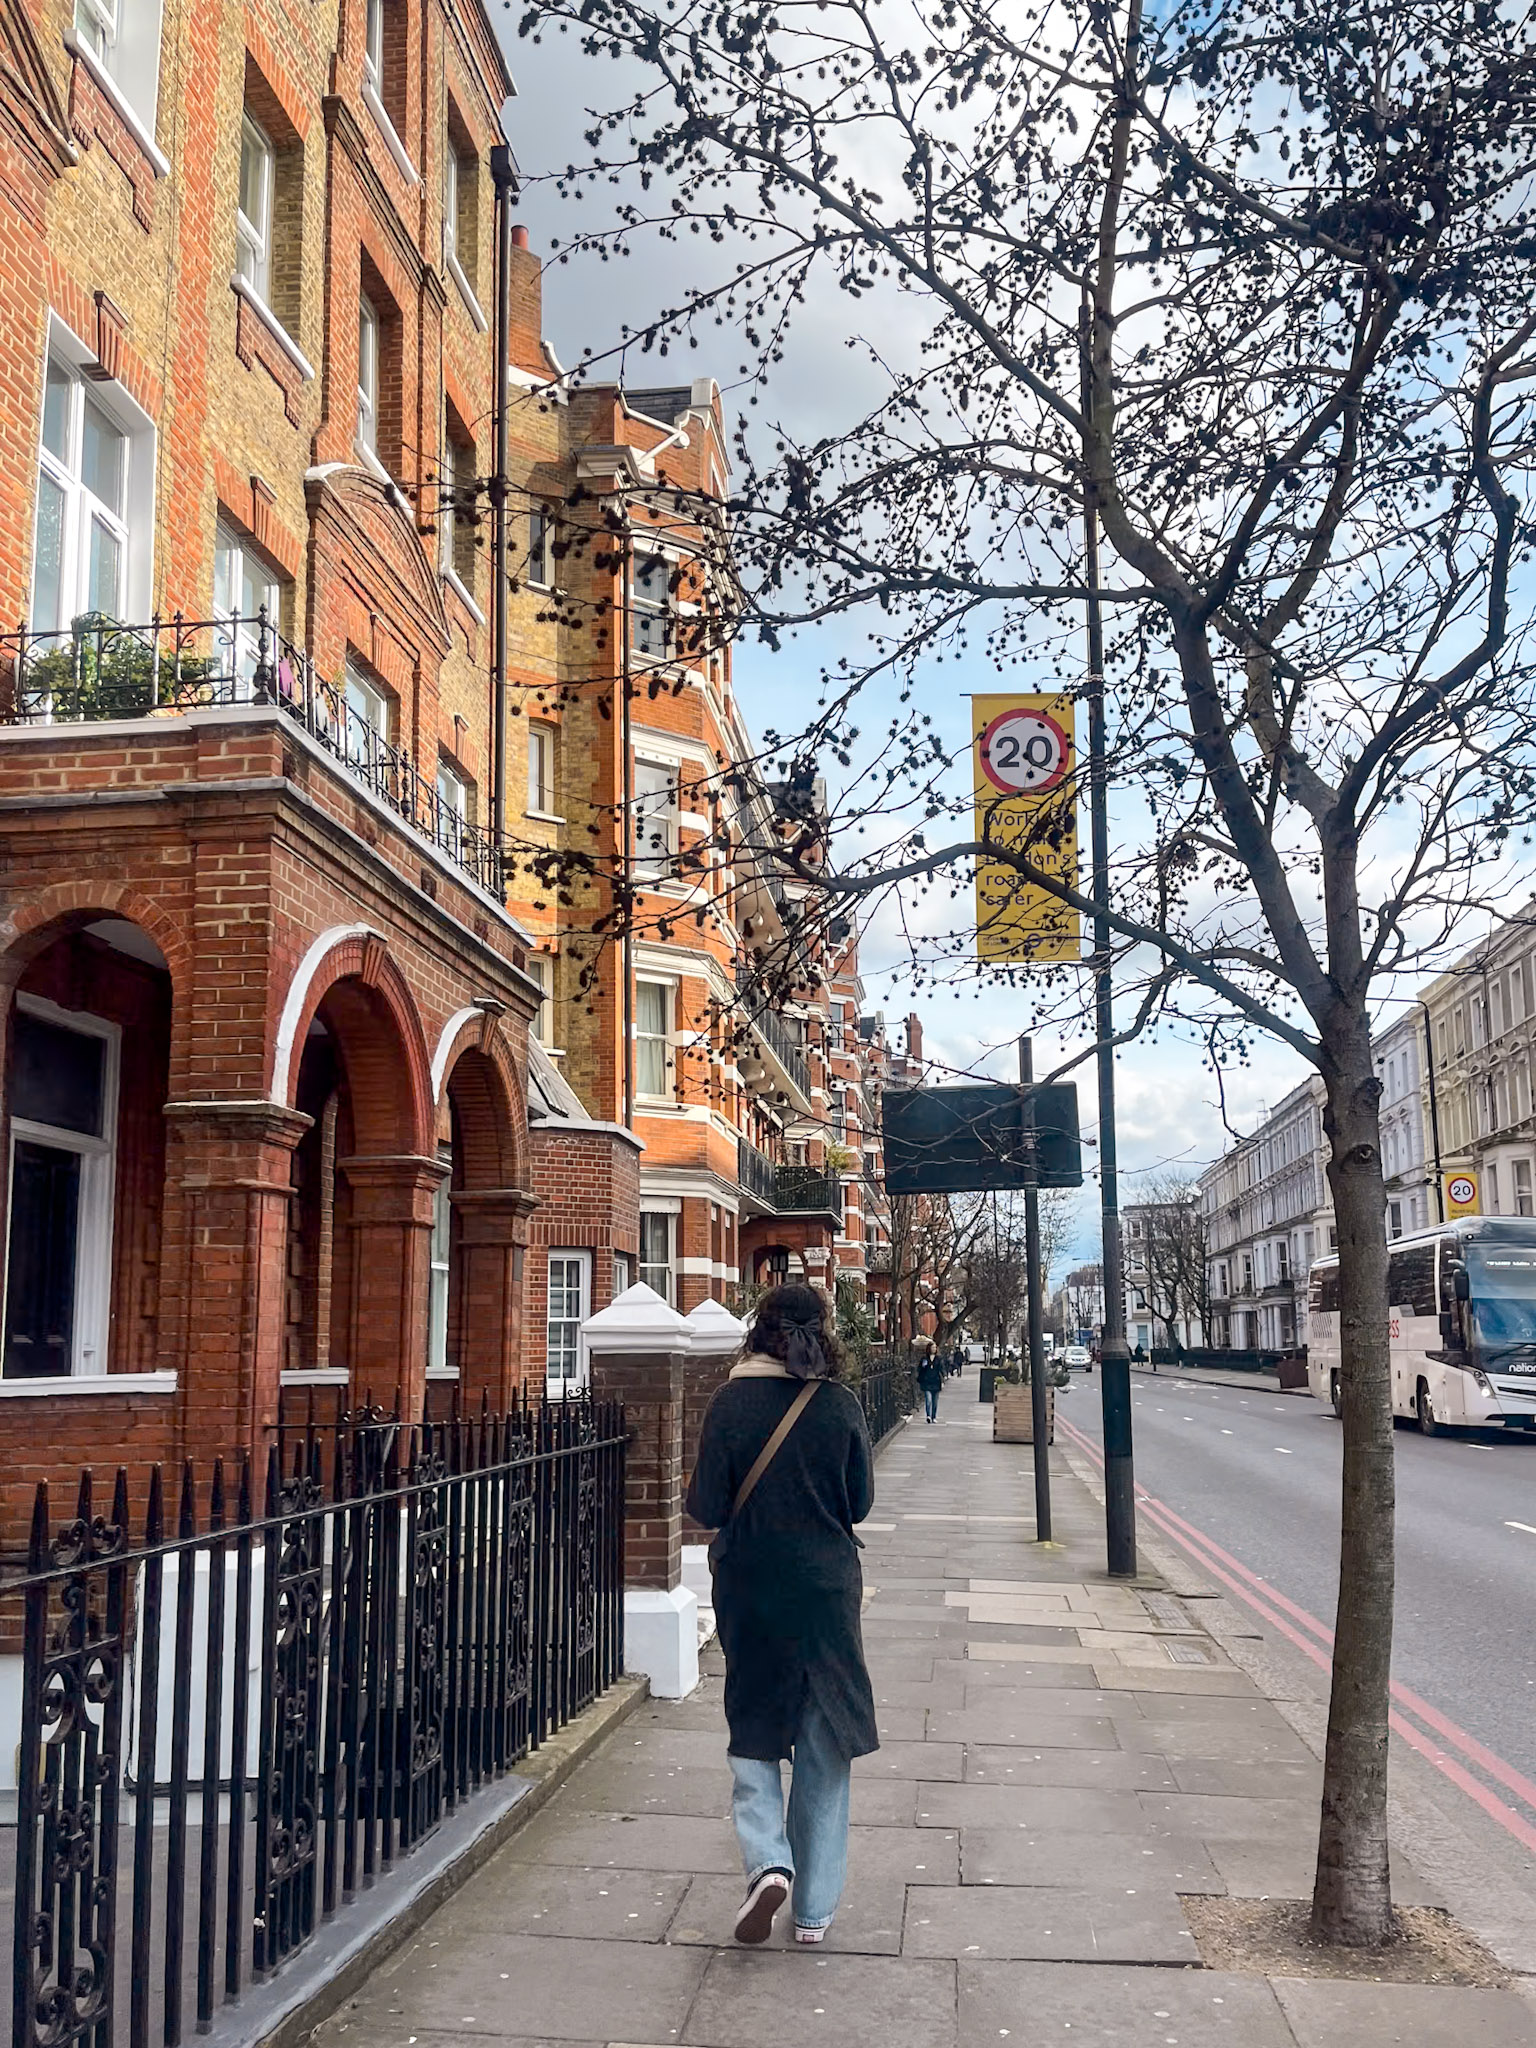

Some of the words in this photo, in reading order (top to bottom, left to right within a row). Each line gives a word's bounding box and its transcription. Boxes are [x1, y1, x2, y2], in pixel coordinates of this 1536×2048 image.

[996, 736, 1053, 768] 20
[986, 812, 1056, 828] Work
[986, 872, 1037, 886] roa
[986, 893, 1034, 906] saer
[1453, 1185, 1471, 1196] 20
